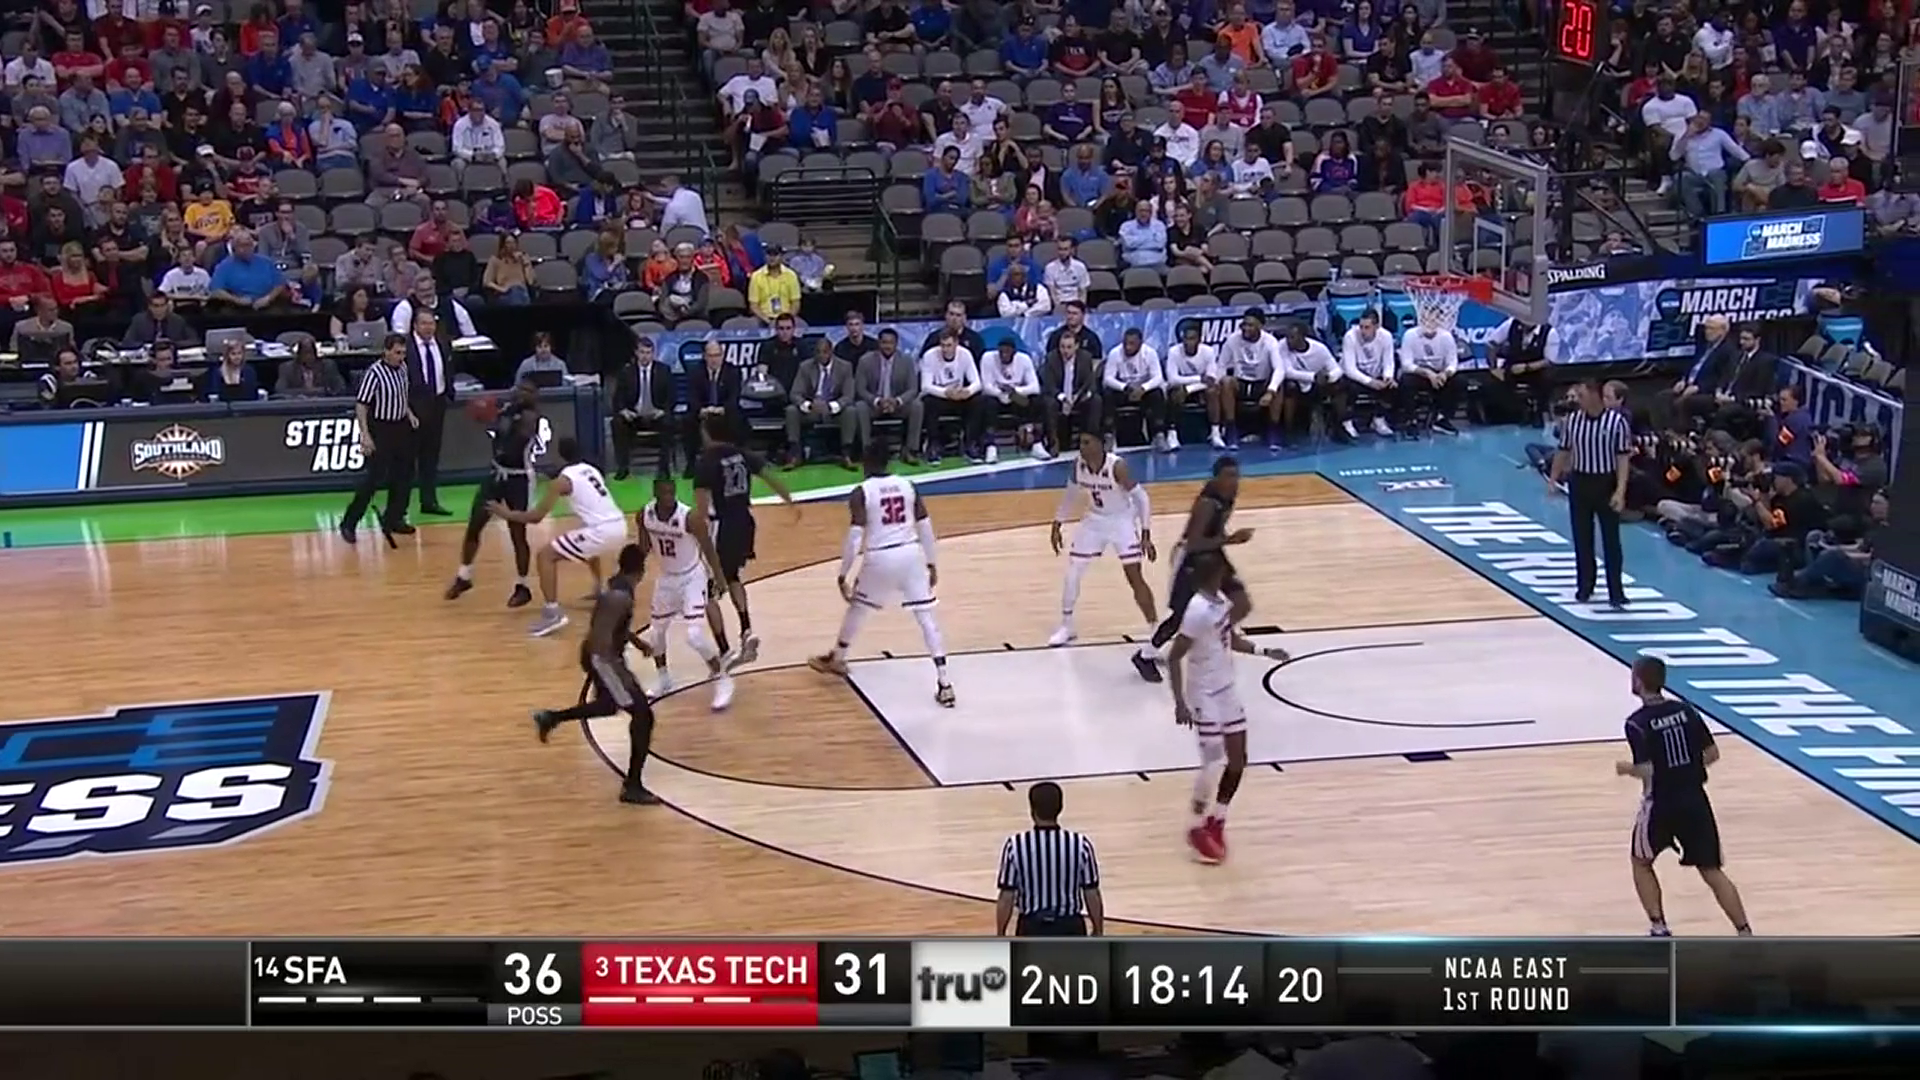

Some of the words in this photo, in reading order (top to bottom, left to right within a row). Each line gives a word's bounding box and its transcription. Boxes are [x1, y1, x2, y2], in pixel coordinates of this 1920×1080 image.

[1561, 2, 1592, 57] 20
[1761, 222, 1803, 238] MARCH
[1766, 232, 1821, 250] MADNESS
[1547, 264, 1606, 285] SPALDING
[1681, 287, 1758, 314] MARCH
[133, 439, 222, 465] SOUTHLAND
[880, 496, 906, 525] 32
[1402, 500, 1570, 546] THE
[658, 538, 677, 558] 12
[1882, 568, 1917, 600] MARCH
[1608, 627, 1780, 667] TO
[1686, 673, 1914, 737] THE
